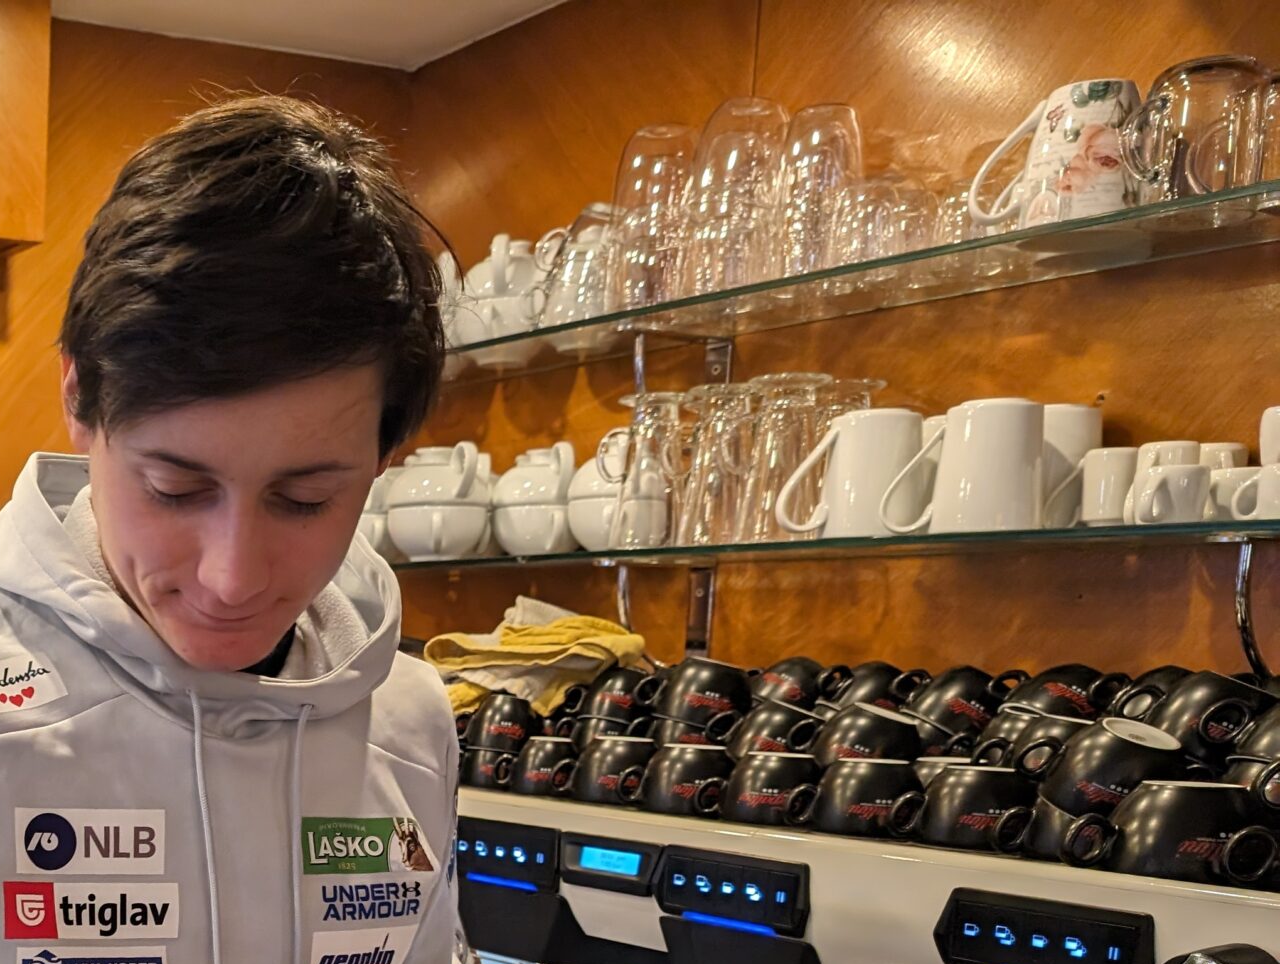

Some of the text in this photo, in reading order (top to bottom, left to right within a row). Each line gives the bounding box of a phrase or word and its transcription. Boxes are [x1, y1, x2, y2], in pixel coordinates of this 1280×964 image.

[84, 826, 156, 858] NLB
[307, 832, 384, 865] LAŠKO
[322, 883, 400, 902] UNDER
[59, 893, 170, 936] triglav
[323, 899, 419, 921] ARMOUR
